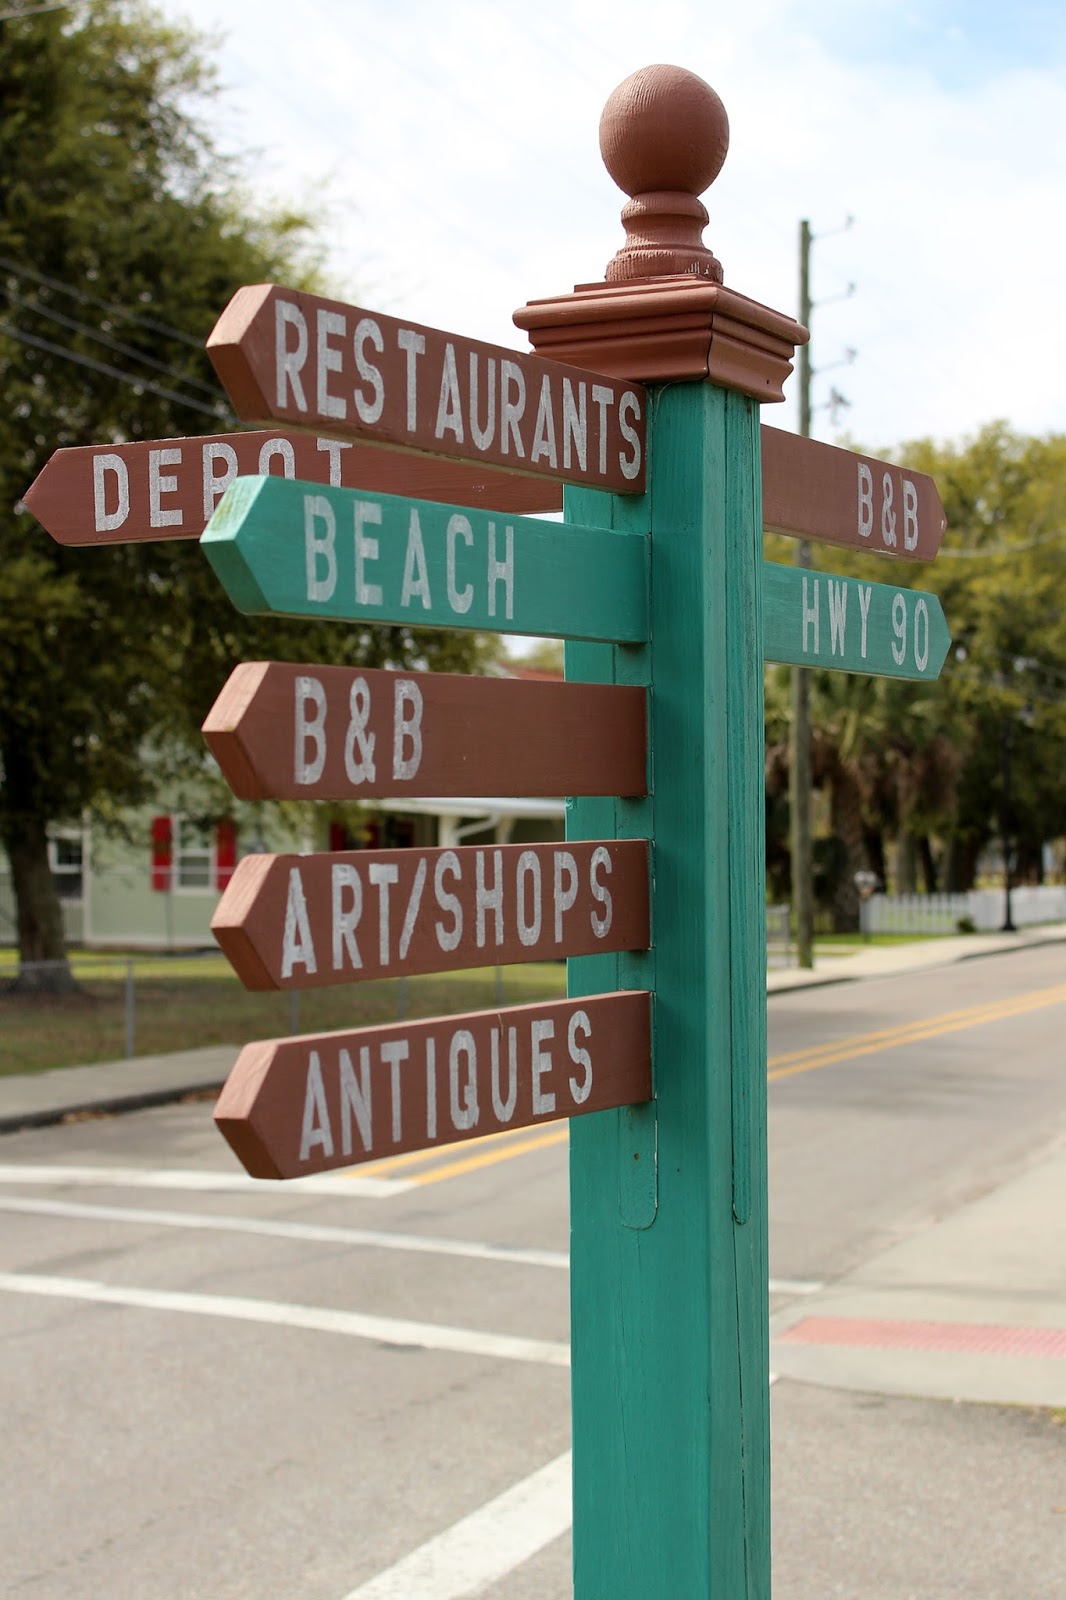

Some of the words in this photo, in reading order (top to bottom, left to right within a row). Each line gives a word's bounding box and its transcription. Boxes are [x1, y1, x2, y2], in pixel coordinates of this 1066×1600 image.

[275, 299, 641, 480] RESTAURANTS
[304, 494, 515, 620] BEACH
[857, 462, 918, 551] B&B
[801, 577, 873, 659] HWY
[891, 592, 930, 673] 90
[294, 677, 424, 785] B&B
[280, 846, 613, 979] ART/SHOPS
[298, 1010, 593, 1163] ANTIQUES
